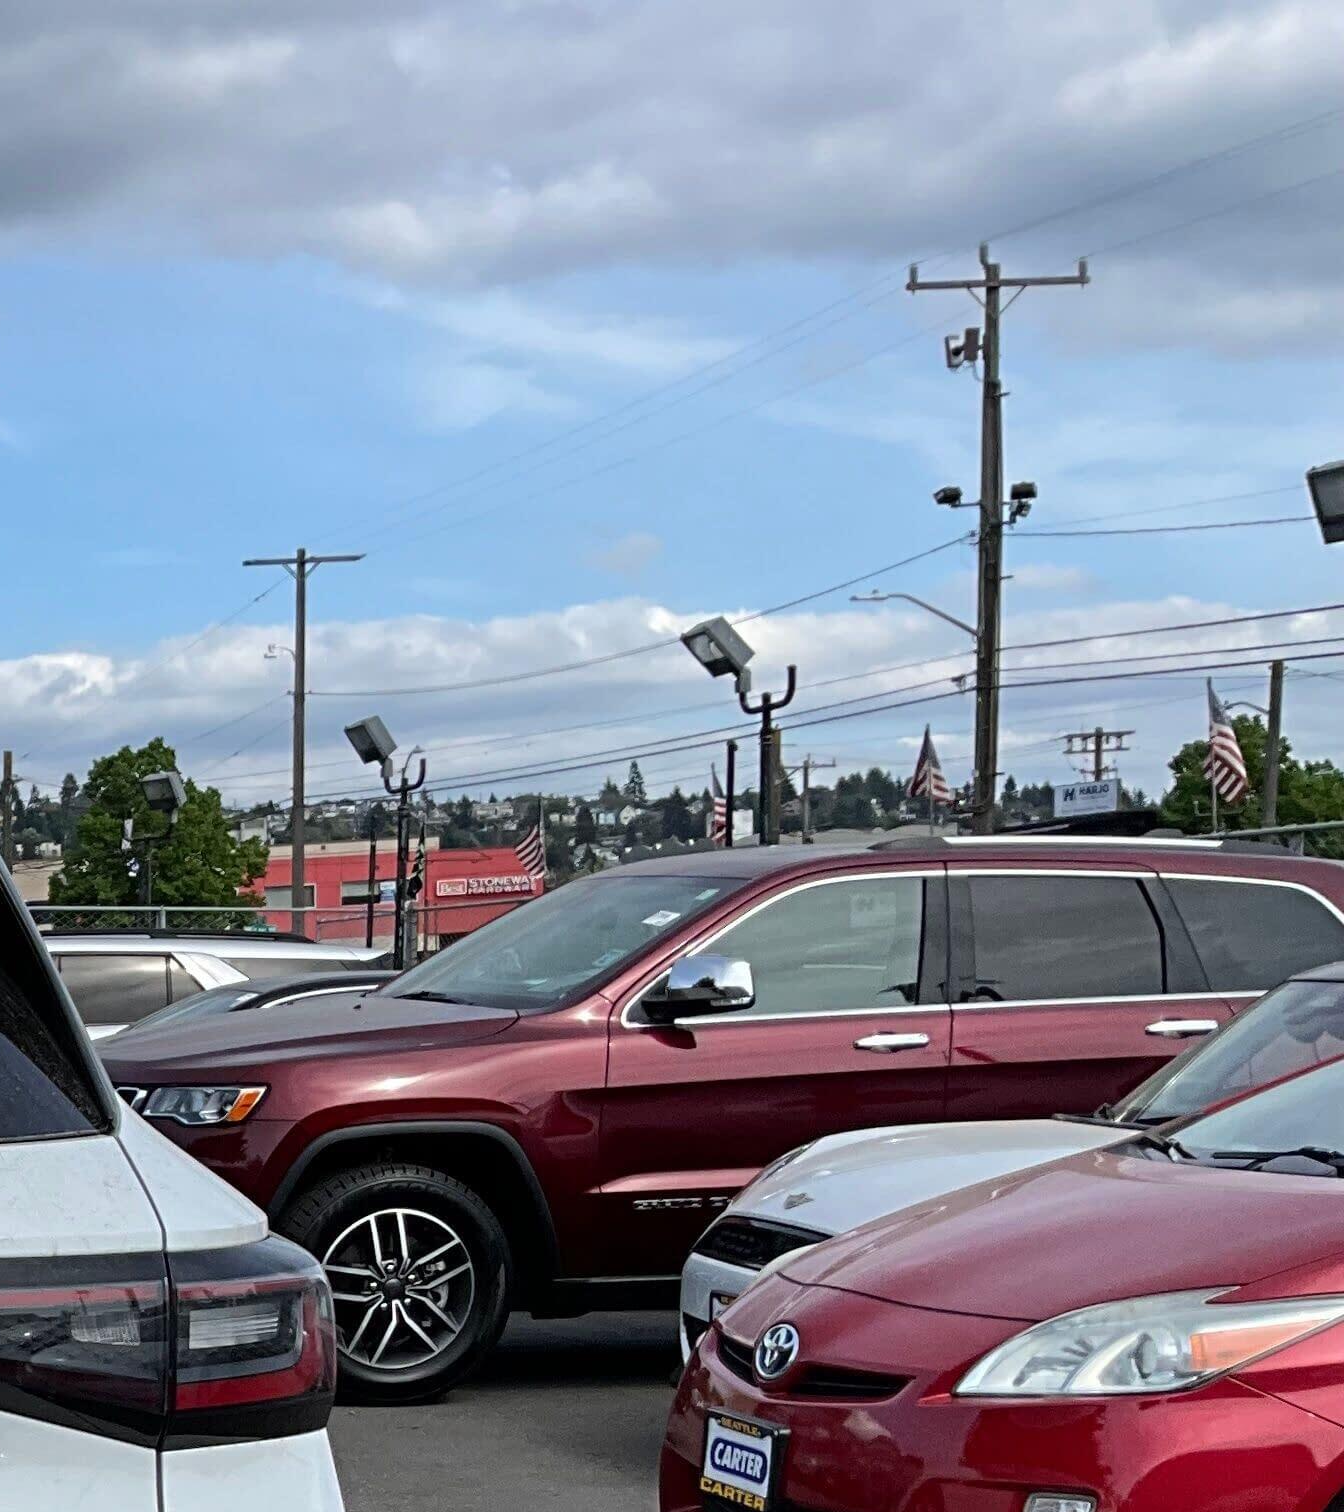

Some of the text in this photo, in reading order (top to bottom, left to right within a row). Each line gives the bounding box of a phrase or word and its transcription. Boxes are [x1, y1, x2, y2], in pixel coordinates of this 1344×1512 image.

[468, 875, 535, 888] STONEWAY
[714, 1442, 763, 1479] CARTER
[700, 1477, 765, 1512] CARTER
